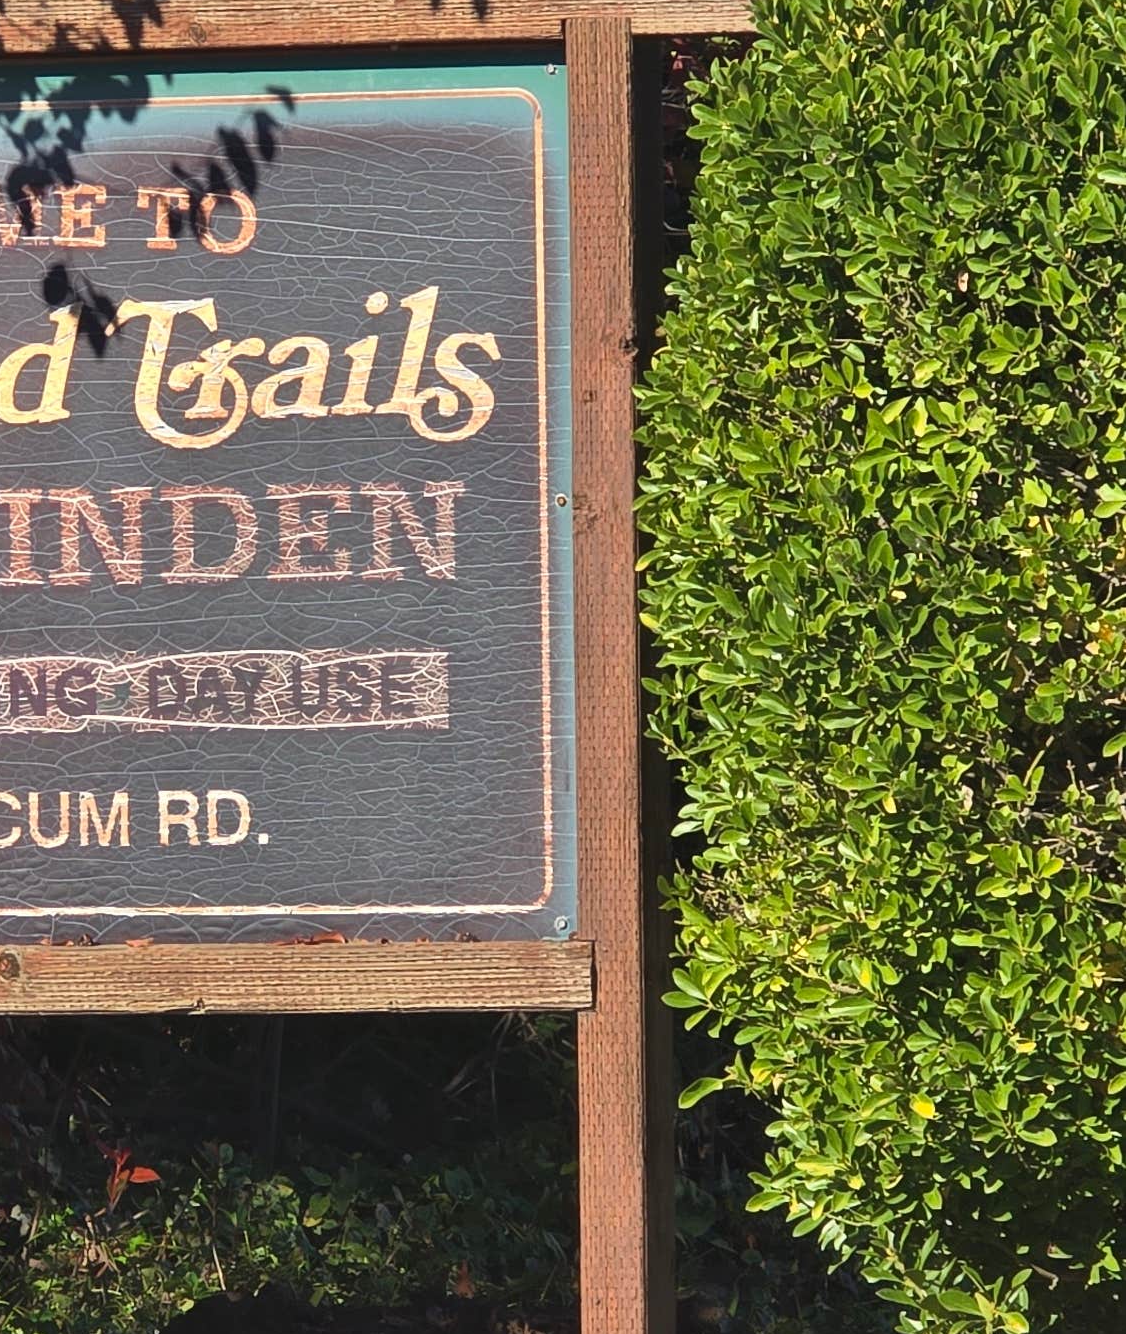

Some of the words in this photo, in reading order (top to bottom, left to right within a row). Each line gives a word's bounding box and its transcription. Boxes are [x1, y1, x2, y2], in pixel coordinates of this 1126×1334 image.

[136, 187, 258, 254] TO
[104, 285, 502, 449] Trails
[148, 666, 271, 718] DAY
[292, 666, 416, 718] USE
[158, 789, 271, 847] RD.
